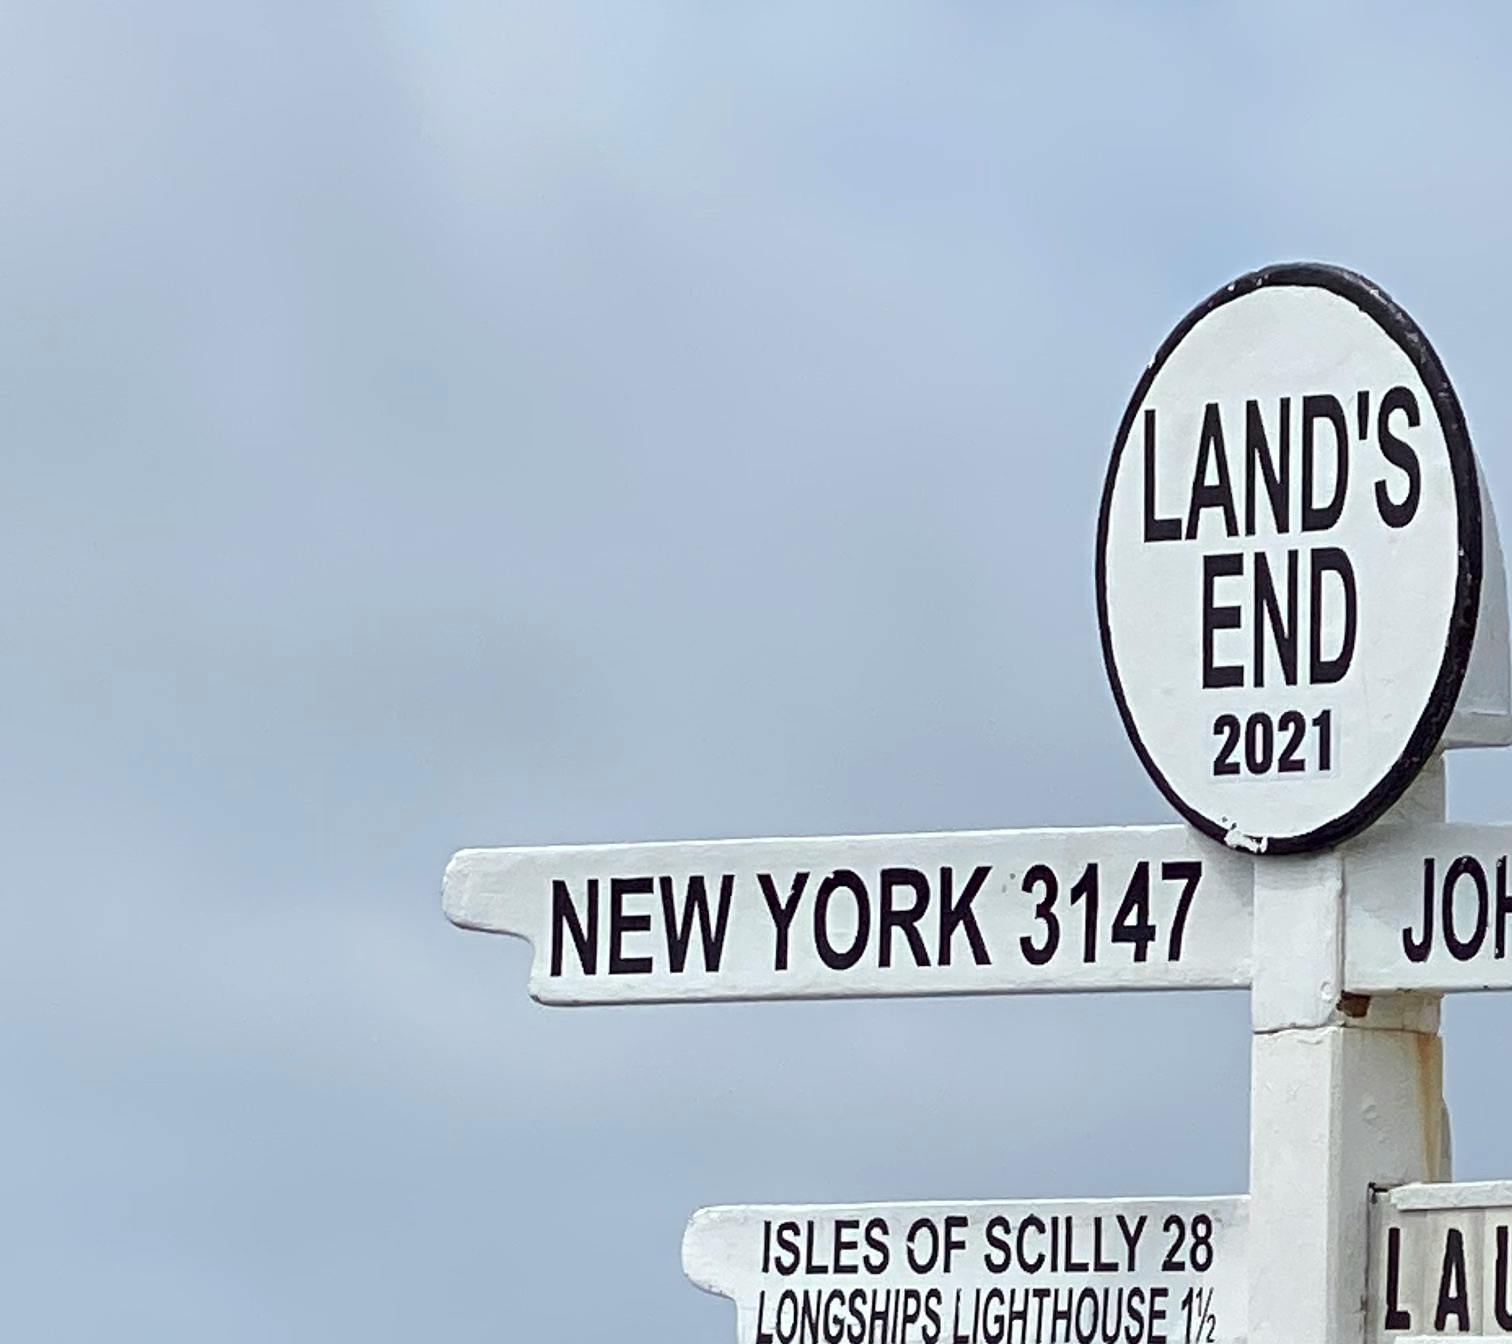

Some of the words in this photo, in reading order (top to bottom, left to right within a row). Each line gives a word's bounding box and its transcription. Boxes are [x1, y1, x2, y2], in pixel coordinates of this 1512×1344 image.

[1143, 386, 1421, 543] LAND'S
[1202, 547, 1356, 689] END
[1213, 709, 1331, 776] 2021
[551, 873, 734, 977] NEW
[757, 865, 992, 972] YORK
[1019, 860, 1203, 967] 3147
[761, 1218, 890, 1275] ISLES
[905, 1217, 968, 1275] OF
[983, 1215, 1147, 1273] SCILLY
[1161, 1213, 1215, 1273] 28
